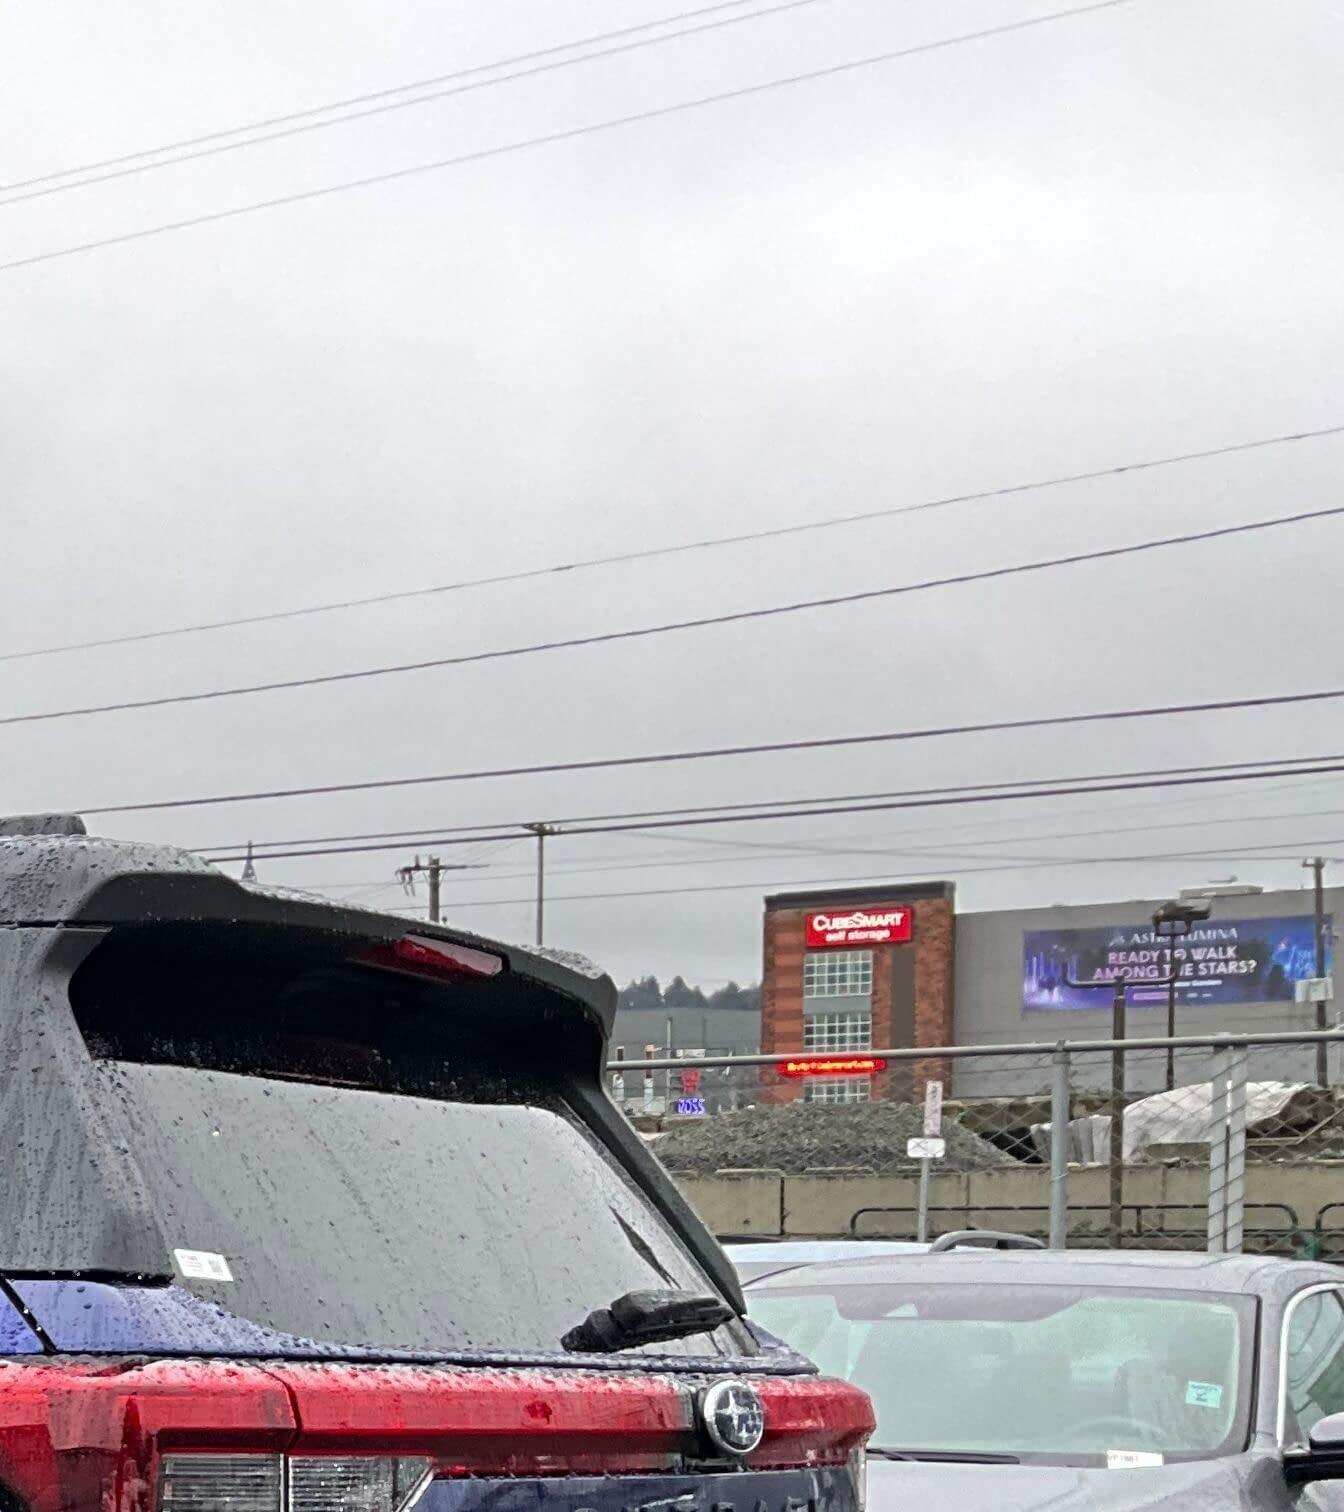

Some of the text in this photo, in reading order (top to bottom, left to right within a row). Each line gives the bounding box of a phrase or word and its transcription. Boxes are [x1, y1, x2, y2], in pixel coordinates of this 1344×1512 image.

[1108, 950, 1160, 964] READY
[1191, 946, 1238, 961] WALK
[1093, 965, 1159, 980] AMONG
[1198, 960, 1257, 976] STARS?
